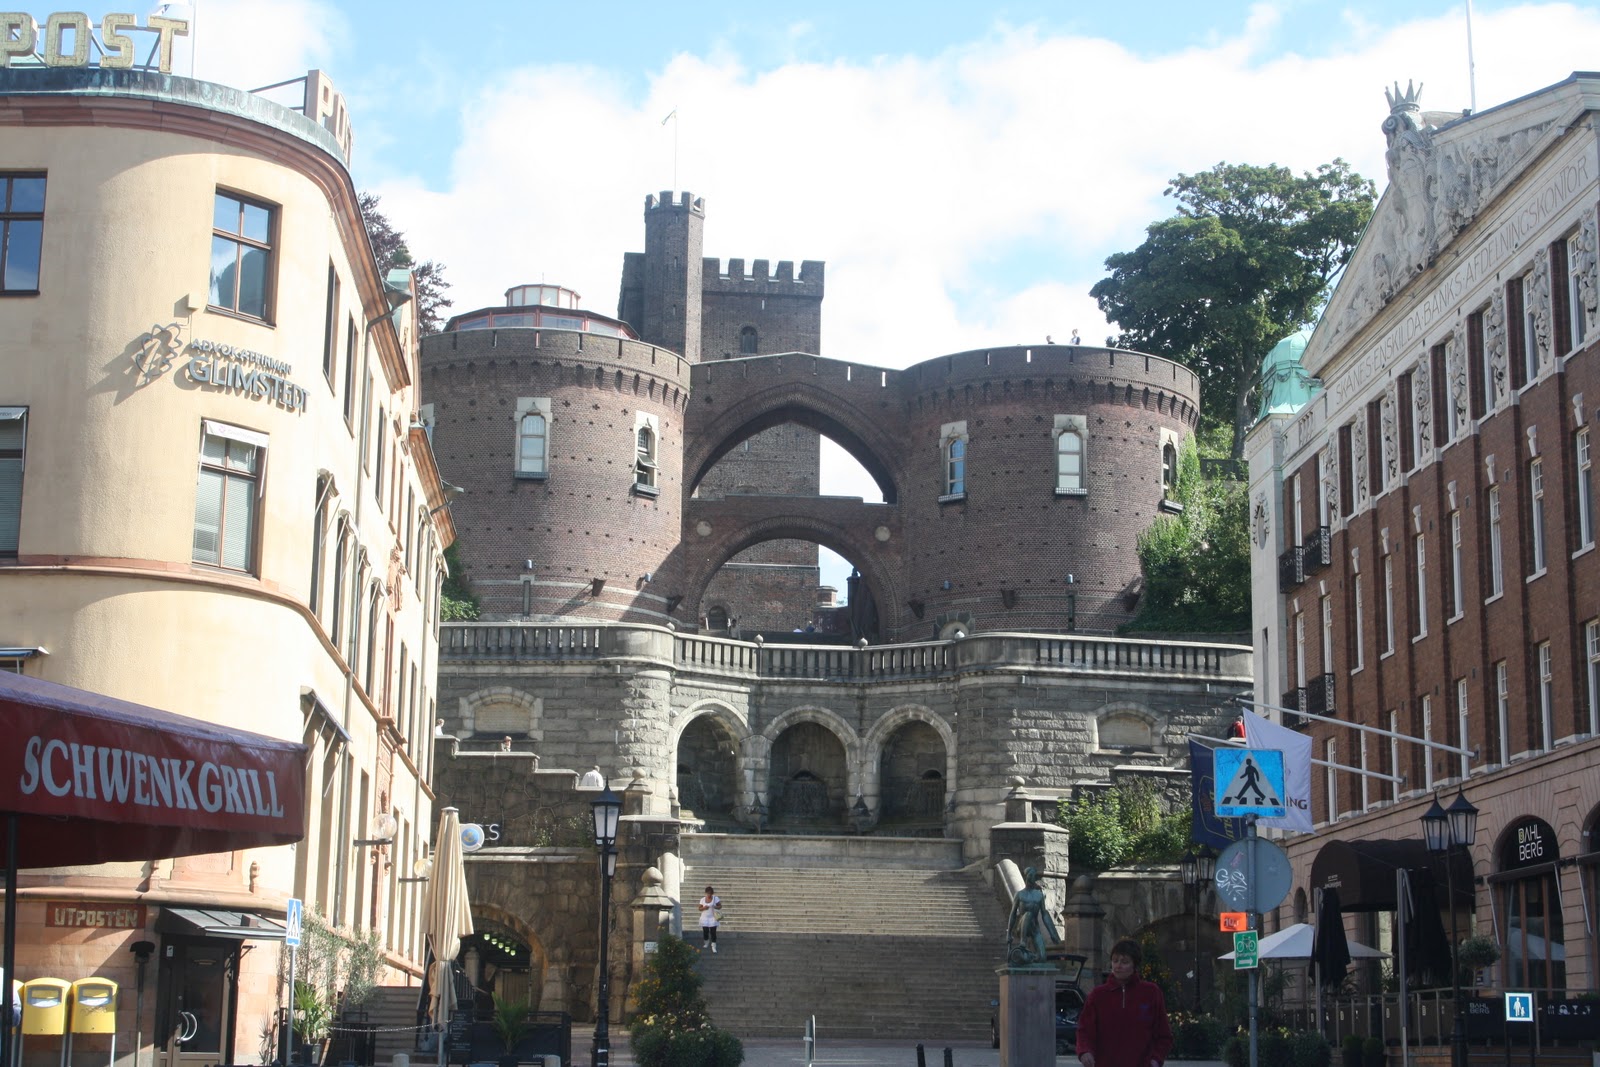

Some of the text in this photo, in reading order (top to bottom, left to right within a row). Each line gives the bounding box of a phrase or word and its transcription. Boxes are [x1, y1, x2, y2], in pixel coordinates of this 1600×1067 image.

[0, 11, 189, 74] POST
[191, 338, 292, 375] ADVOKATFIRMAN
[188, 355, 311, 414] GLIMSTEDT
[1518, 824, 1542, 844] DAHL
[1519, 840, 1544, 861] BERG
[54, 907, 138, 927] UTPOSTEN
